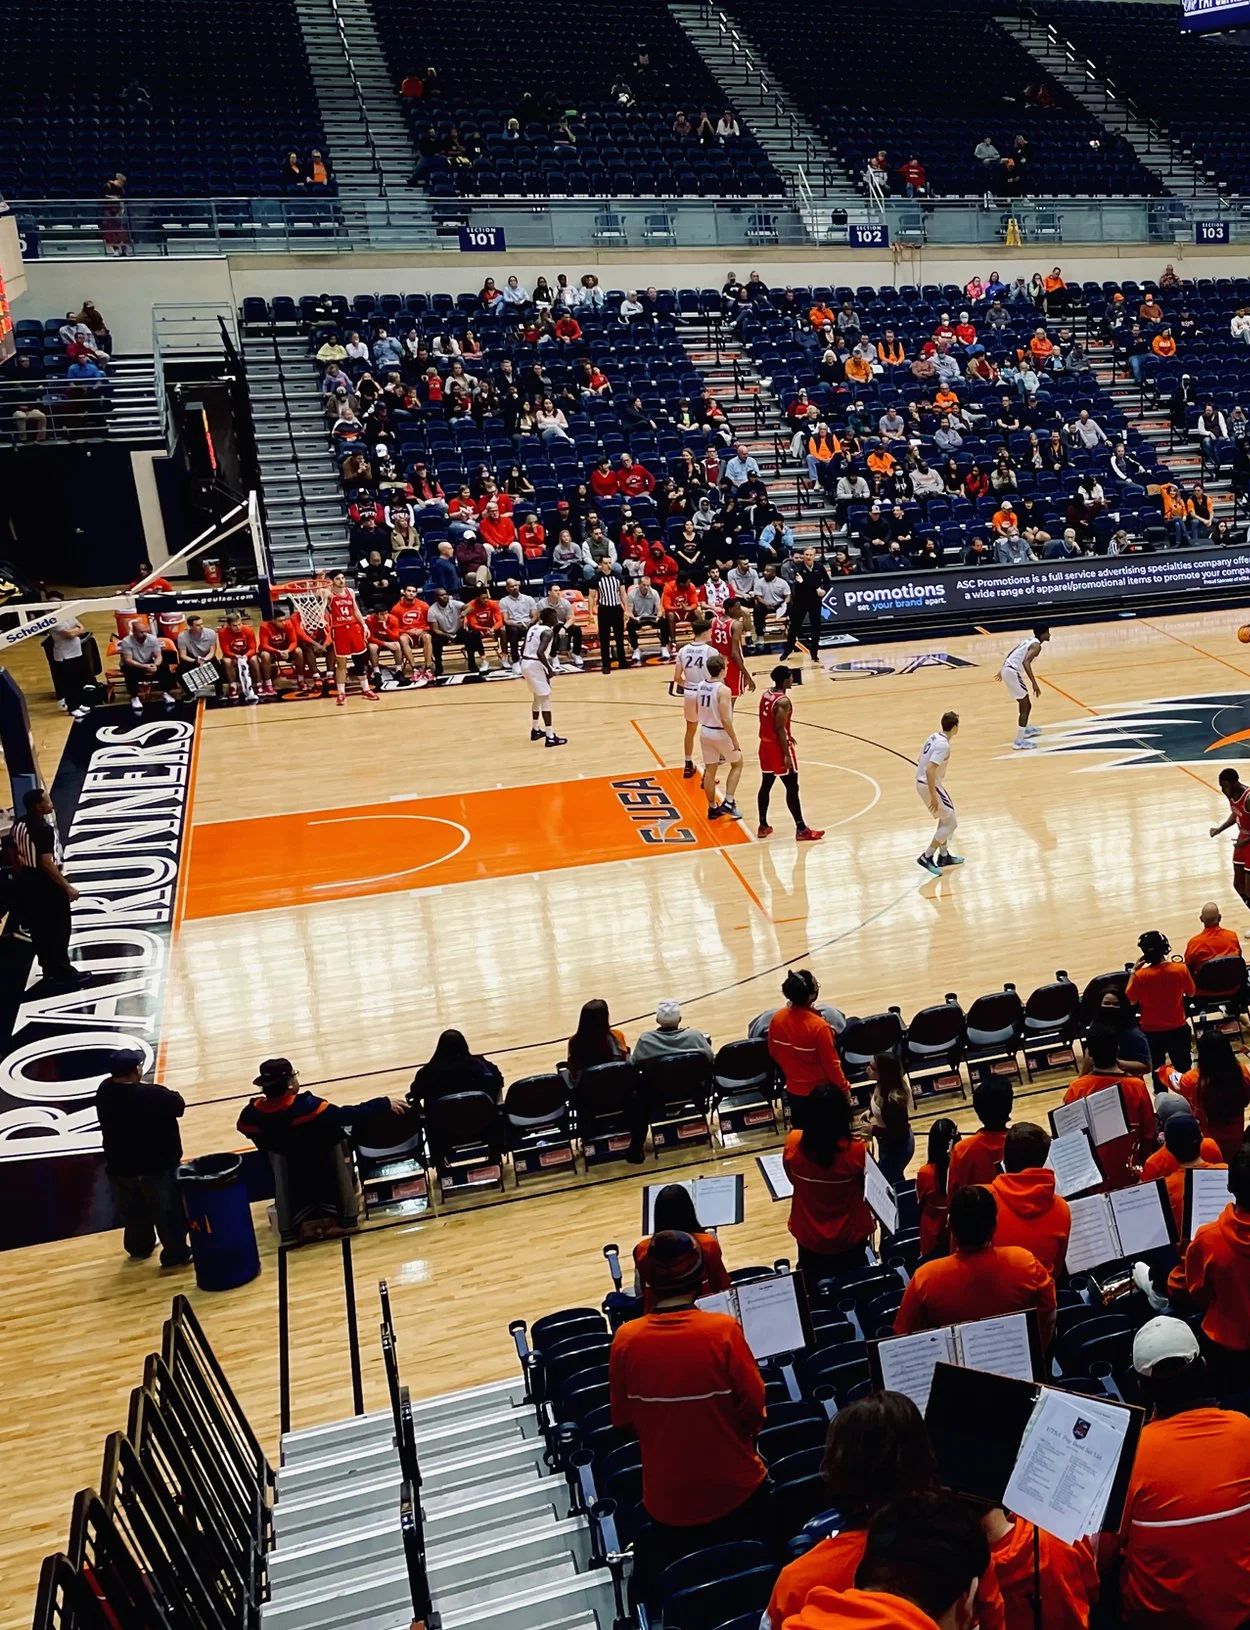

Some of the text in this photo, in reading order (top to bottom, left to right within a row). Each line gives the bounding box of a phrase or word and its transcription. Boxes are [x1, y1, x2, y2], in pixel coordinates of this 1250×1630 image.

[469, 233, 495, 245] 101
[857, 231, 882, 242] 102
[1202, 228, 1224, 239] 103
[956, 580, 976, 589] ASC
[977, 575, 1030, 588] Promotions
[1031, 574, 1039, 583] is
[1048, 572, 1064, 581] full
[1064, 570, 1096, 580] service
[1097, 565, 1147, 578] advertising
[1147, 560, 1192, 574] specialties
[1193, 560, 1232, 571] company
[971, 589, 995, 599] wide
[997, 587, 1024, 598] range
[1025, 584, 1035, 594] of
[1036, 575, 1126, 595] apparel/promotional
[1127, 575, 1152, 586] items
[1153, 574, 1164, 583] to
[1164, 571, 1201, 583] promote
[1201, 570, 1220, 580] your
[176, 594, 254, 605] www.goutsa.com
[844, 583, 946, 606] promotions
[858, 604, 870, 612] set
[872, 601, 894, 612] your
[895, 597, 922, 610] brand
[6, 616, 58, 643] Schelde
[714, 629, 728, 645] 33
[685, 655, 704, 669] 24
[700, 694, 711, 708] 11
